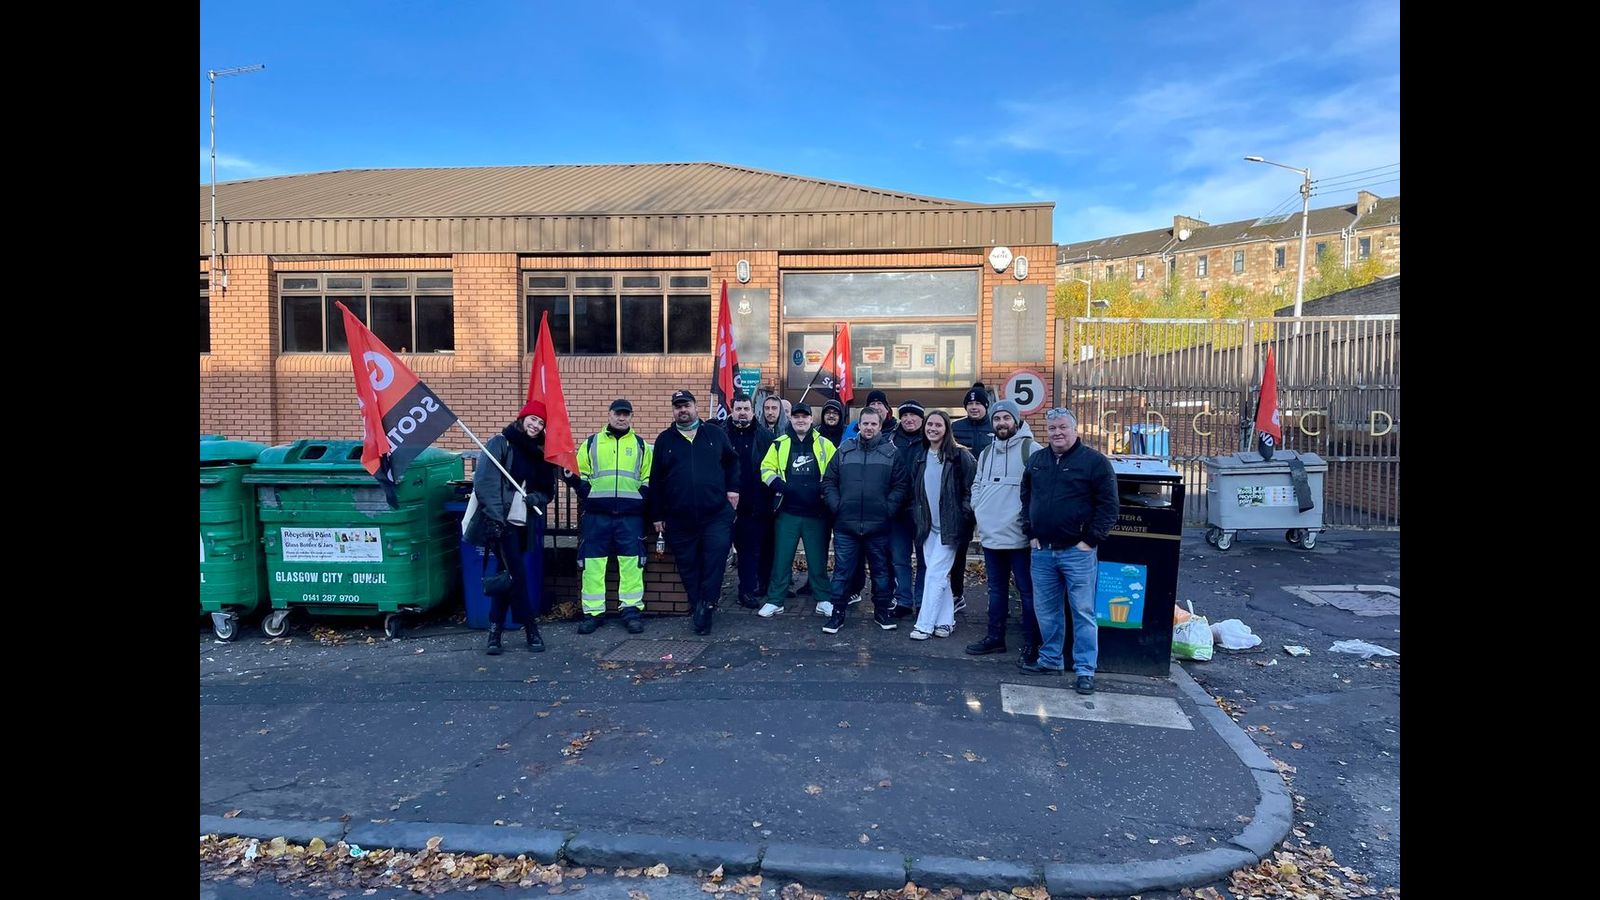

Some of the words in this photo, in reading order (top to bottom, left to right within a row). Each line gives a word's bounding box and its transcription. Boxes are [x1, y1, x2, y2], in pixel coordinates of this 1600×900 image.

[1014, 379, 1034, 405] 5
[1100, 411, 1118, 435] G
[1146, 411, 1165, 436] D
[1193, 411, 1212, 436] C
[1300, 411, 1321, 436] C
[1370, 411, 1392, 436] D
[1121, 525, 1148, 533] WASTE
[284, 531, 315, 541] Recycling
[275, 571, 318, 583] GLASGOW
[322, 572, 343, 583] CITY
[349, 572, 387, 584] OUNCIL
[302, 594, 320, 602] 0141
[322, 594, 337, 602] 287
[339, 595, 360, 603] 9700
